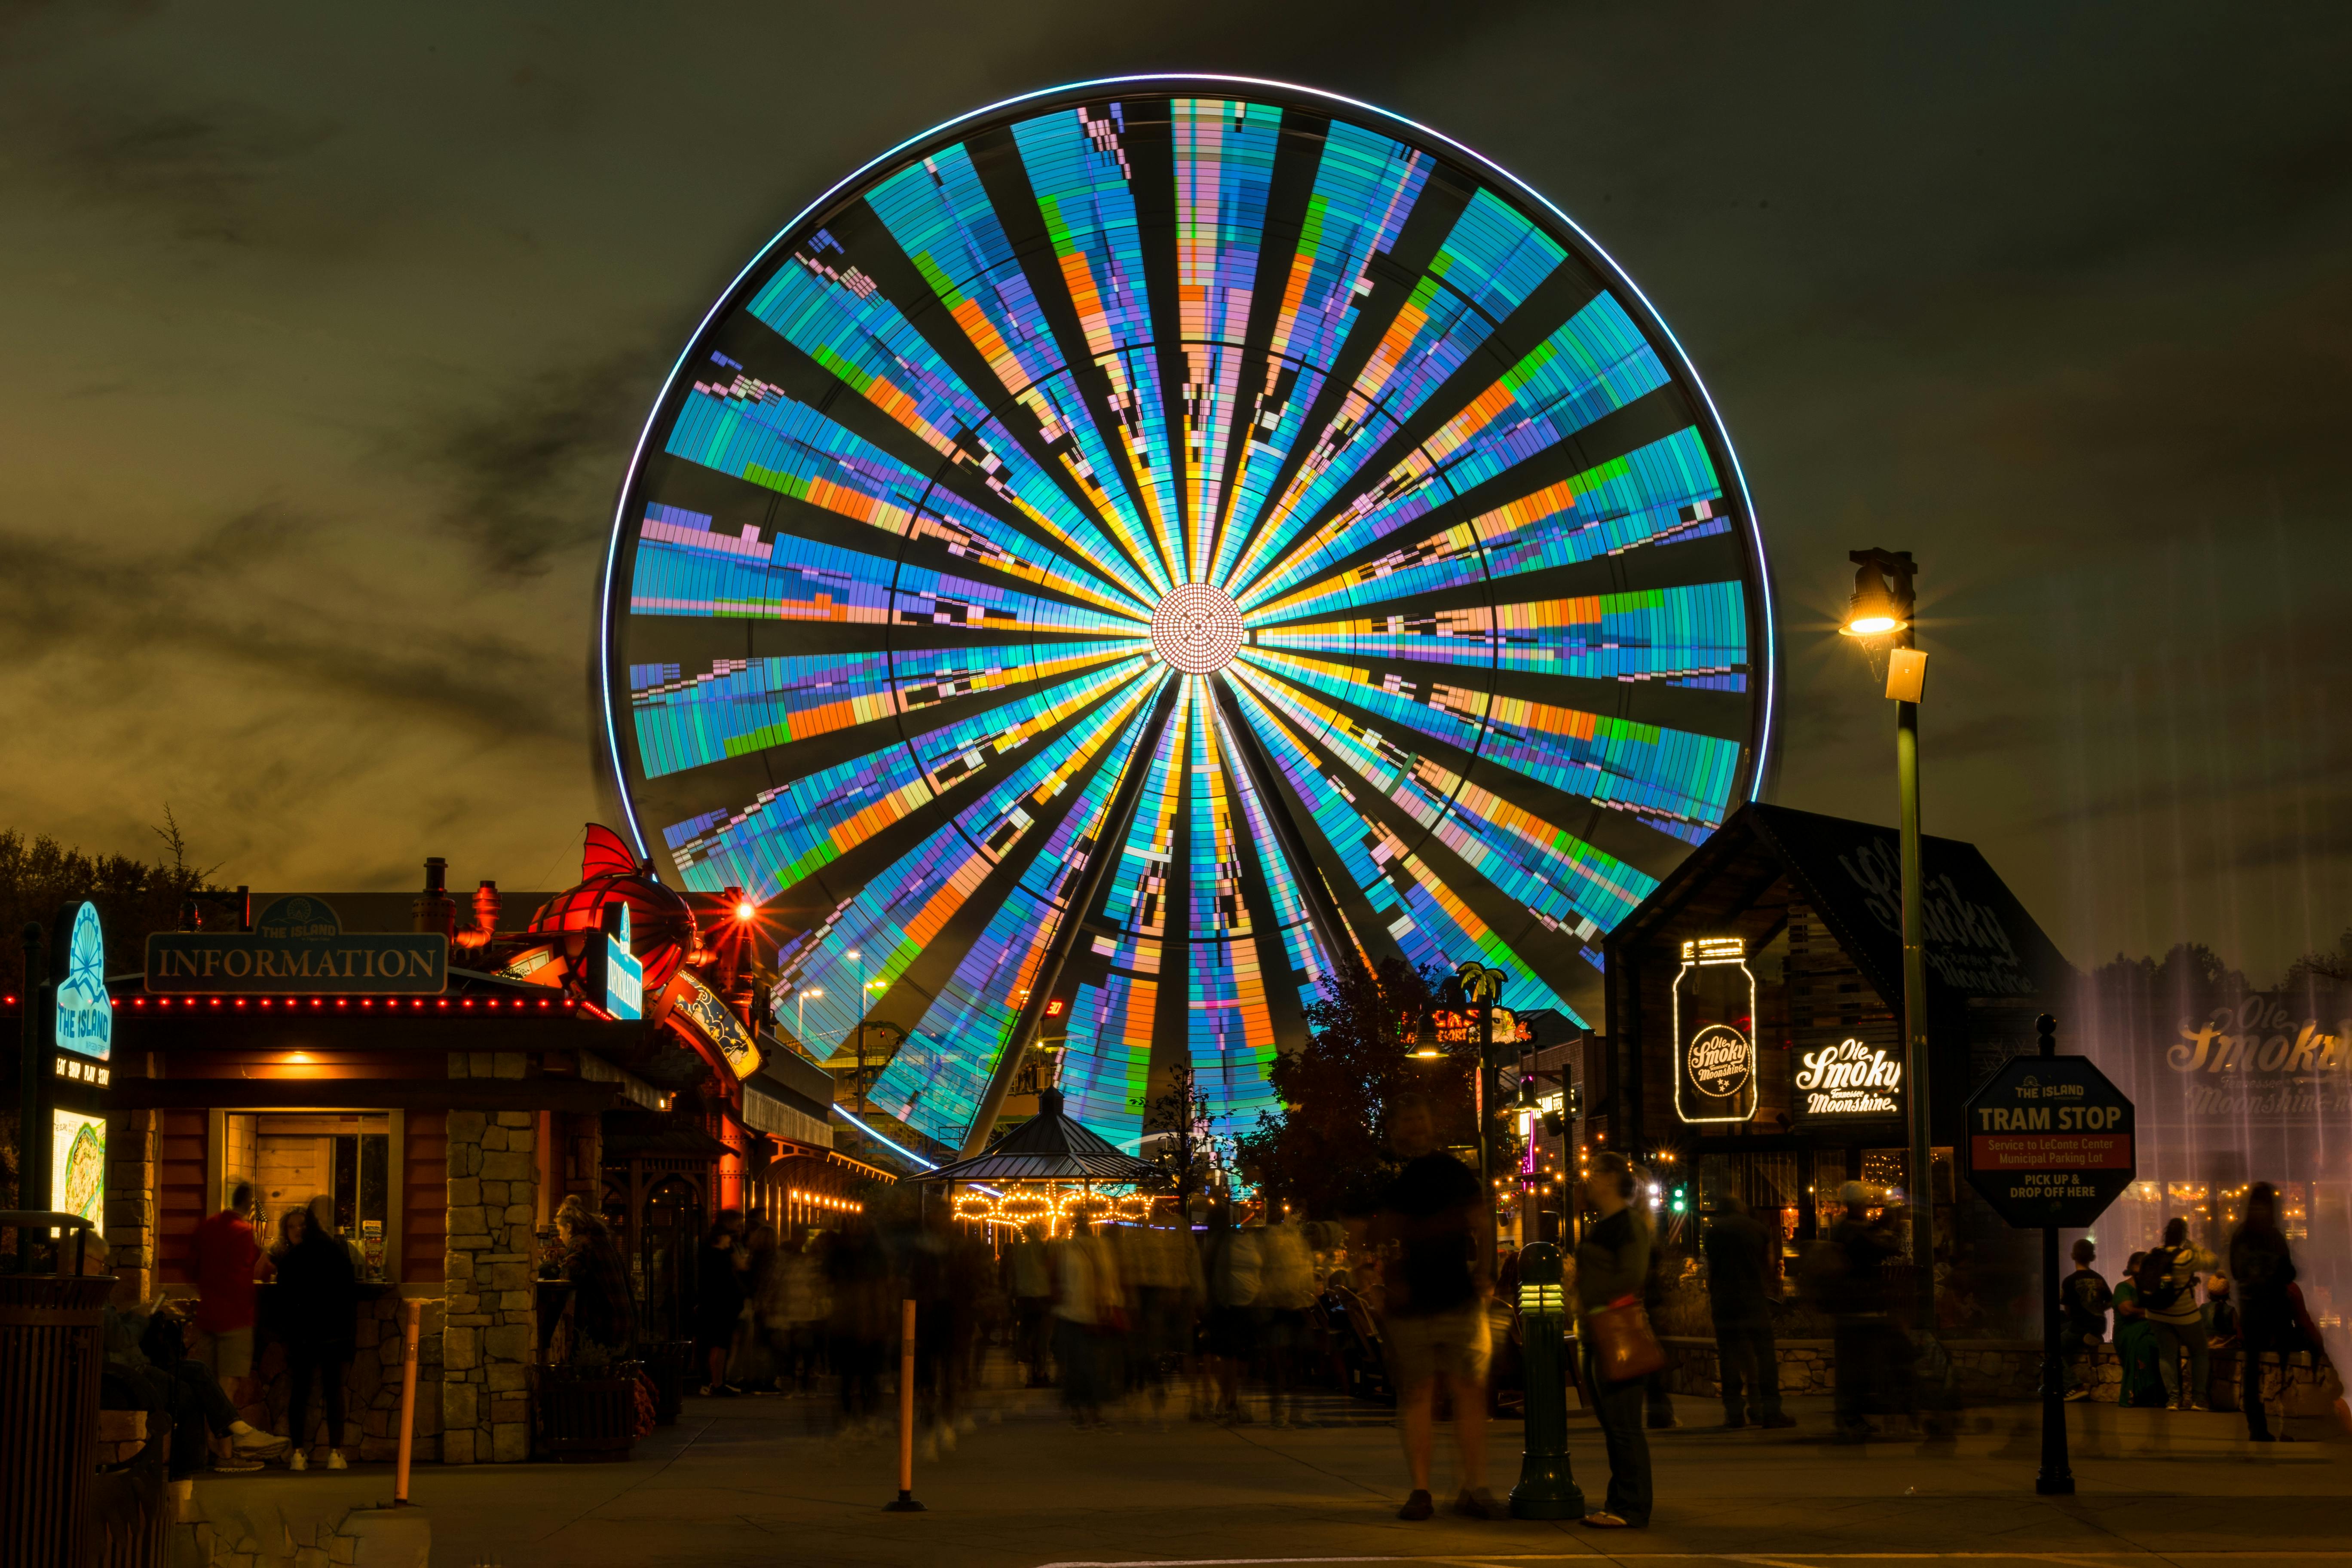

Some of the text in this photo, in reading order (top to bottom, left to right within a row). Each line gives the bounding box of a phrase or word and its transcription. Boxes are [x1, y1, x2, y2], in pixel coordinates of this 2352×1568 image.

[261, 923, 337, 938] THE ISLAND
[157, 949, 436, 978] INFORMATION
[608, 955, 641, 1014] INFORMATION
[1047, 1001, 1062, 1014] 30
[2237, 995, 2299, 1032] Ole
[58, 1004, 108, 1043] THE ISLAND
[1711, 1035, 1730, 1050] Ole
[1838, 1038, 1874, 1062] Ole
[1691, 1039, 1748, 1068] Smoky
[56, 1058, 109, 1086] EAT SHOP PLAY STAY
[1698, 1064, 1746, 1081] Moonshine
[1796, 1046, 1901, 1094] Smoky
[1830, 1088, 1864, 1099] Tennessee
[2015, 1084, 2084, 1099] THE ISLAND
[1807, 1093, 1897, 1114] Moonshine
[1978, 1106, 2122, 1131] TRAM STOP
[1988, 1138, 2114, 1150] Service to LeConte Center
[2000, 1152, 2104, 1166] Municipal Parking Lot
[2025, 1173, 2080, 1185] PICK UP &
[2010, 1186, 2096, 1198] DROP OFF HERE
